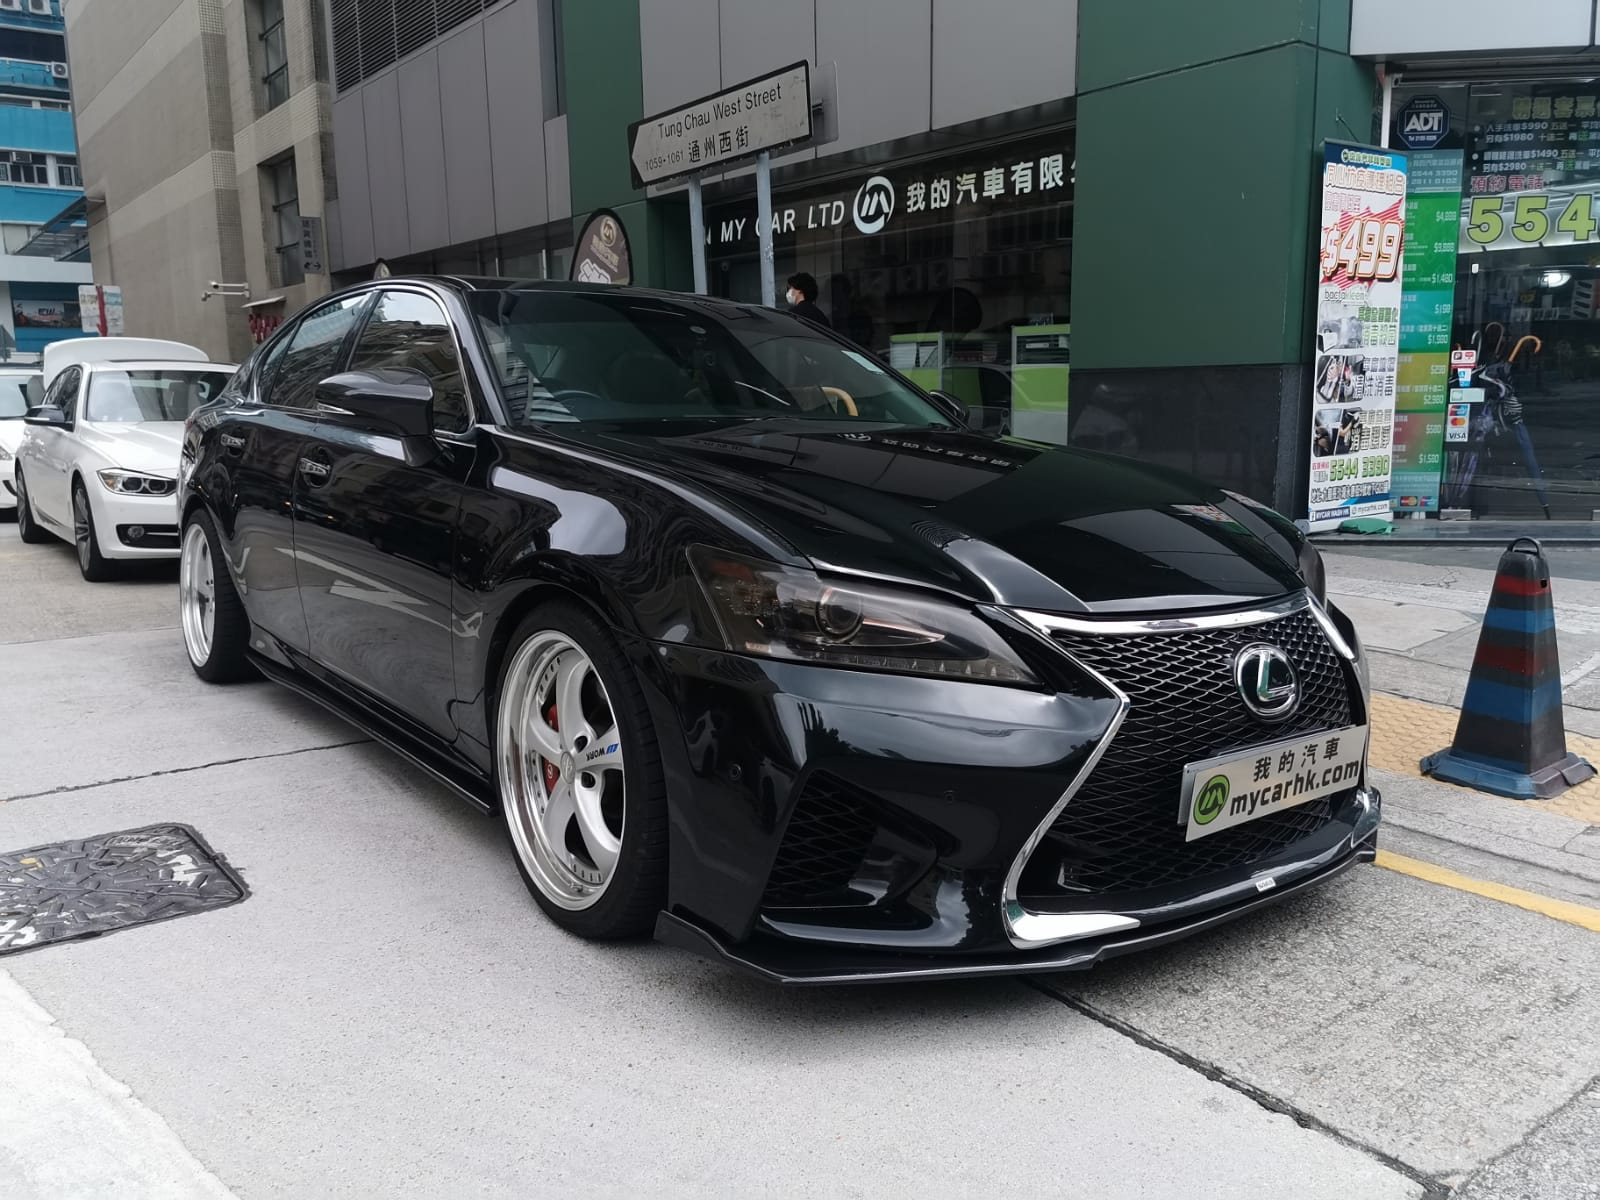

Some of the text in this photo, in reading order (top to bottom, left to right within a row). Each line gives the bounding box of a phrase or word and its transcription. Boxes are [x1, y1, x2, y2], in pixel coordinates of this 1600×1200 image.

[658, 83, 783, 138] Tung Chau West Street
[1404, 112, 1443, 132] ADT
[688, 126, 749, 163] 通州西街
[906, 154, 1075, 213] 我的汽車有限
[720, 217, 746, 243] MY
[807, 200, 845, 229] LTD
[1321, 218, 1404, 280] $499
[1449, 432, 1466, 440] VISA
[1329, 457, 1358, 481] 5544
[1362, 454, 1390, 477] 3390
[586, 747, 606, 762] WORK
[1253, 737, 1340, 783] 我的汽車
[1229, 760, 1360, 817] mycarhk.com
